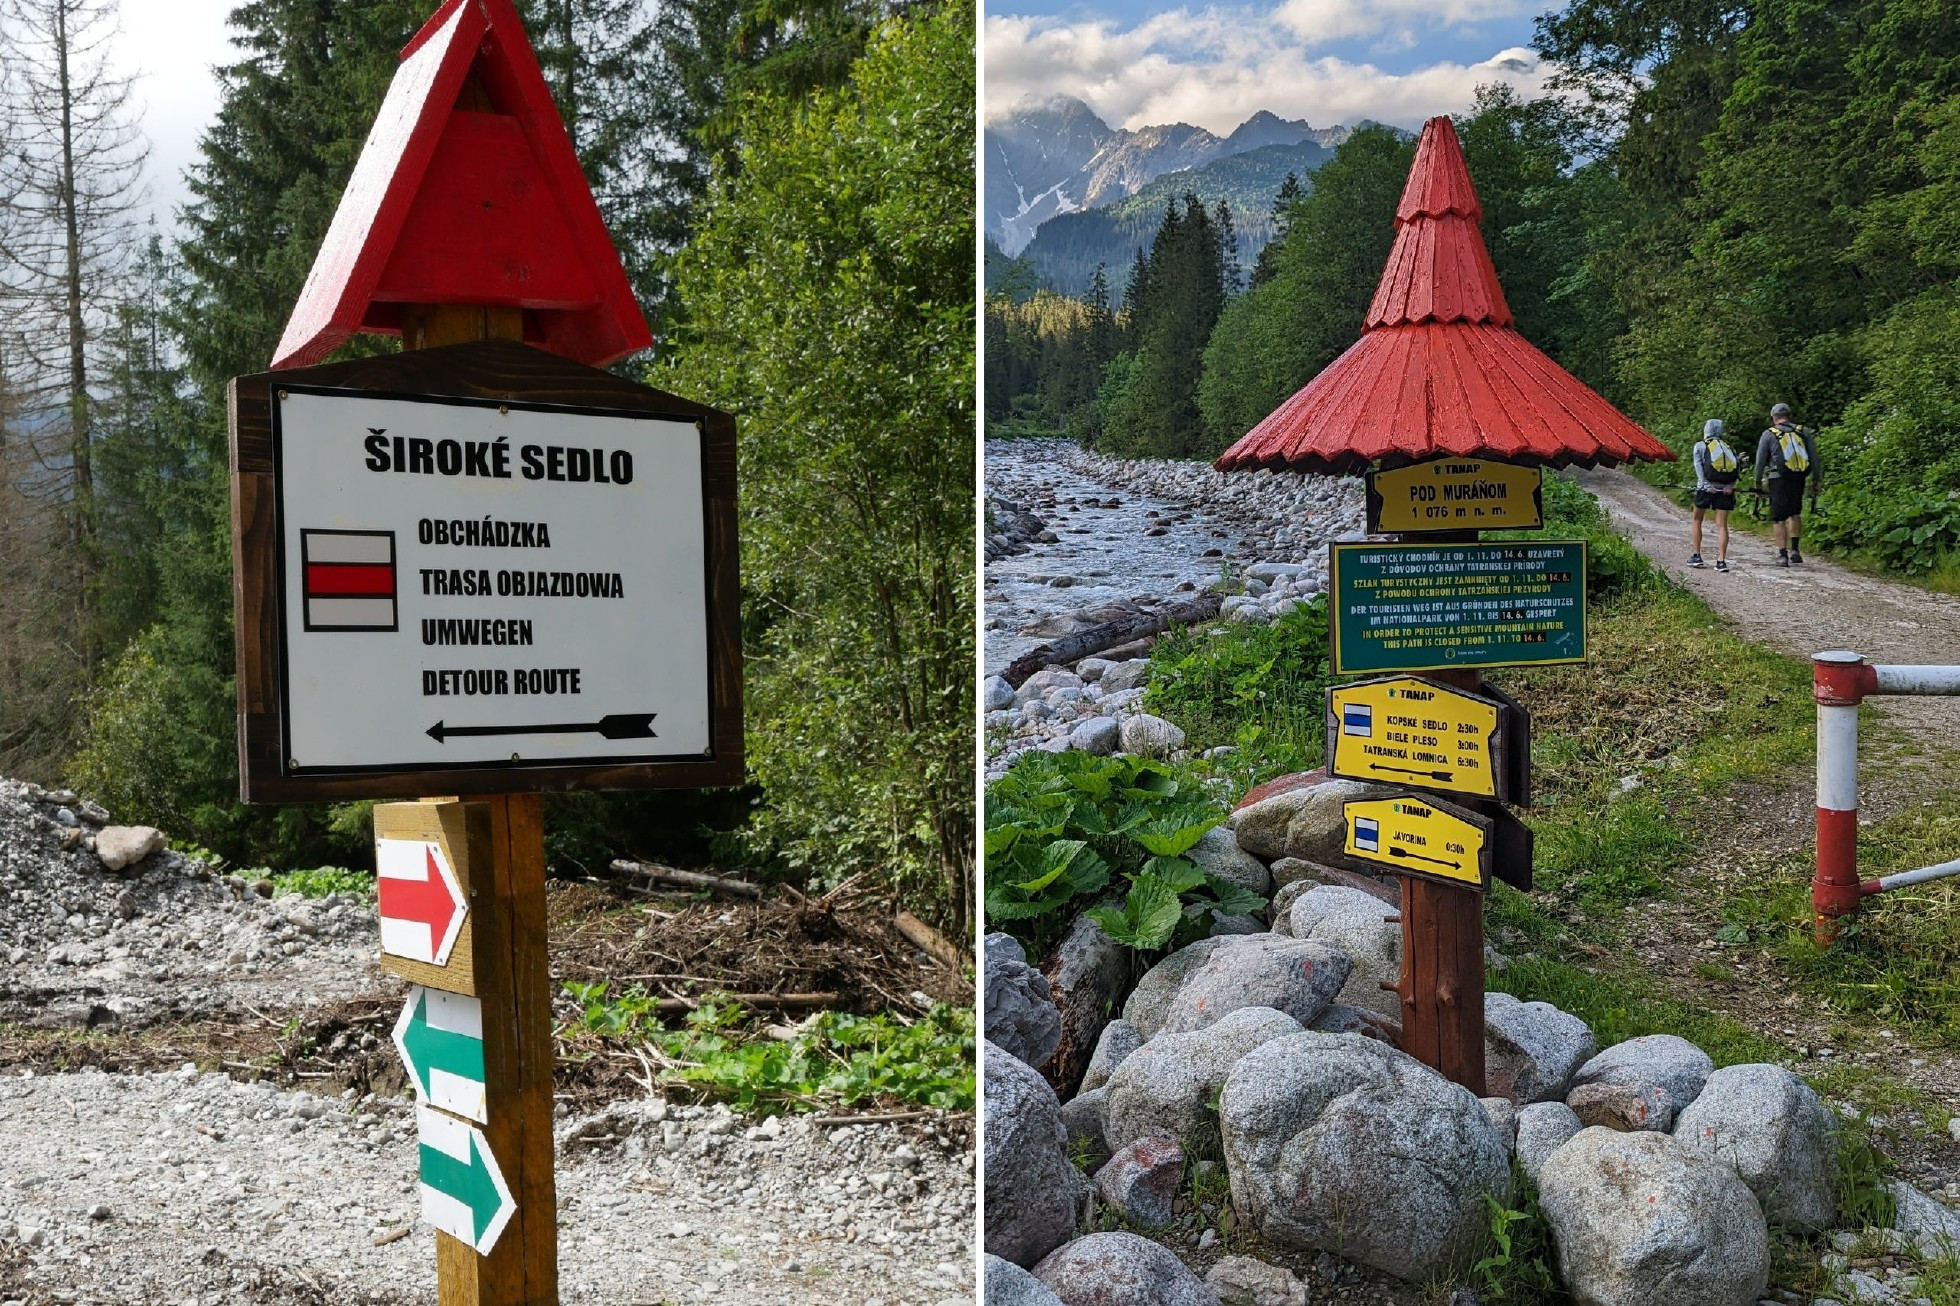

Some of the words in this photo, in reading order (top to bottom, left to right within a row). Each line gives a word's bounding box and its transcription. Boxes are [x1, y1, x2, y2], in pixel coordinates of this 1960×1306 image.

[364, 428, 512, 479] ŠIROKÉ
[520, 444, 634, 485] SEDLO
[1445, 464, 1481, 474] TANAP
[1410, 485, 1436, 501] POD
[1443, 480, 1507, 501] MURÁŇOM
[1412, 507, 1417, 518] 1
[1426, 506, 1448, 518] 076
[1456, 507, 1466, 517] m
[1474, 507, 1484, 516] n.
[1492, 506, 1506, 515] m.
[418, 515, 551, 548] OBCHÁDZKA
[1360, 552, 1403, 564] TURISTICKÝ
[1406, 551, 1440, 562] CHODNÍK
[1454, 552, 1464, 560] OD
[1381, 566, 1386, 574] Z
[1429, 564, 1464, 572] OCHRANY
[1467, 562, 1511, 570] TATRANSKEJ
[419, 569, 492, 596] TRASA
[497, 570, 624, 598] OBJAZDOWA
[1380, 578, 1433, 587] TURYSTYCZNY
[1436, 576, 1452, 586] JEST
[1375, 590, 1380, 598] Z
[1382, 590, 1417, 598] POWODU
[1420, 588, 1456, 596] OCHRONY
[1513, 584, 1552, 593] PRZYRODY
[1351, 606, 1366, 614] DER
[1369, 604, 1410, 614] TOURISTEN
[1412, 604, 1430, 612] WEG
[1432, 602, 1444, 611] IST
[1446, 602, 1460, 610] AUS
[1462, 600, 1498, 610] GRÜNDEN
[1500, 600, 1512, 608] DES
[1514, 598, 1574, 608] NATURSCHUTZES
[1370, 616, 1380, 626] IM
[1383, 614, 1442, 624] NATIONALPARK
[1444, 613, 1460, 622] VON
[1488, 612, 1499, 620] BIS
[1526, 609, 1557, 618] GESPERT
[421, 619, 533, 646] UMWEGEN
[1362, 630, 1371, 638] IN
[1374, 628, 1400, 638] ORDER
[1402, 628, 1412, 636] TO
[1414, 626, 1447, 636] PROTECT
[1448, 626, 1454, 634] A
[1456, 624, 1492, 634] SENSITIVE
[1494, 622, 1534, 632] MOUNTAIN
[1536, 622, 1564, 630] NATURE
[1384, 640, 1400, 648] THIS
[1402, 639, 1422, 648] PATH
[1425, 638, 1432, 646] IS
[1434, 637, 1460, 646] CLOSED
[1464, 636, 1485, 645] FROM
[423, 670, 508, 696] DETOUR
[514, 668, 581, 695] ROUTE
[1400, 689, 1435, 700] TANAP
[1387, 715, 1418, 728] KOPSKÉ
[1422, 720, 1448, 731] SEDLO
[1458, 723, 1478, 734] 2:30h
[1387, 732, 1408, 743] BIELE
[1413, 736, 1438, 746] PLESO
[1458, 740, 1478, 752] 3:00h
[1364, 744, 1408, 760] TATRANSKÁ
[1412, 752, 1448, 764] LOMNICA
[1458, 757, 1478, 768] 6:30h
[1402, 804, 1432, 818] TANAP
[1393, 830, 1427, 846] JAVORINA
[1446, 842, 1464, 854] 0:30h
